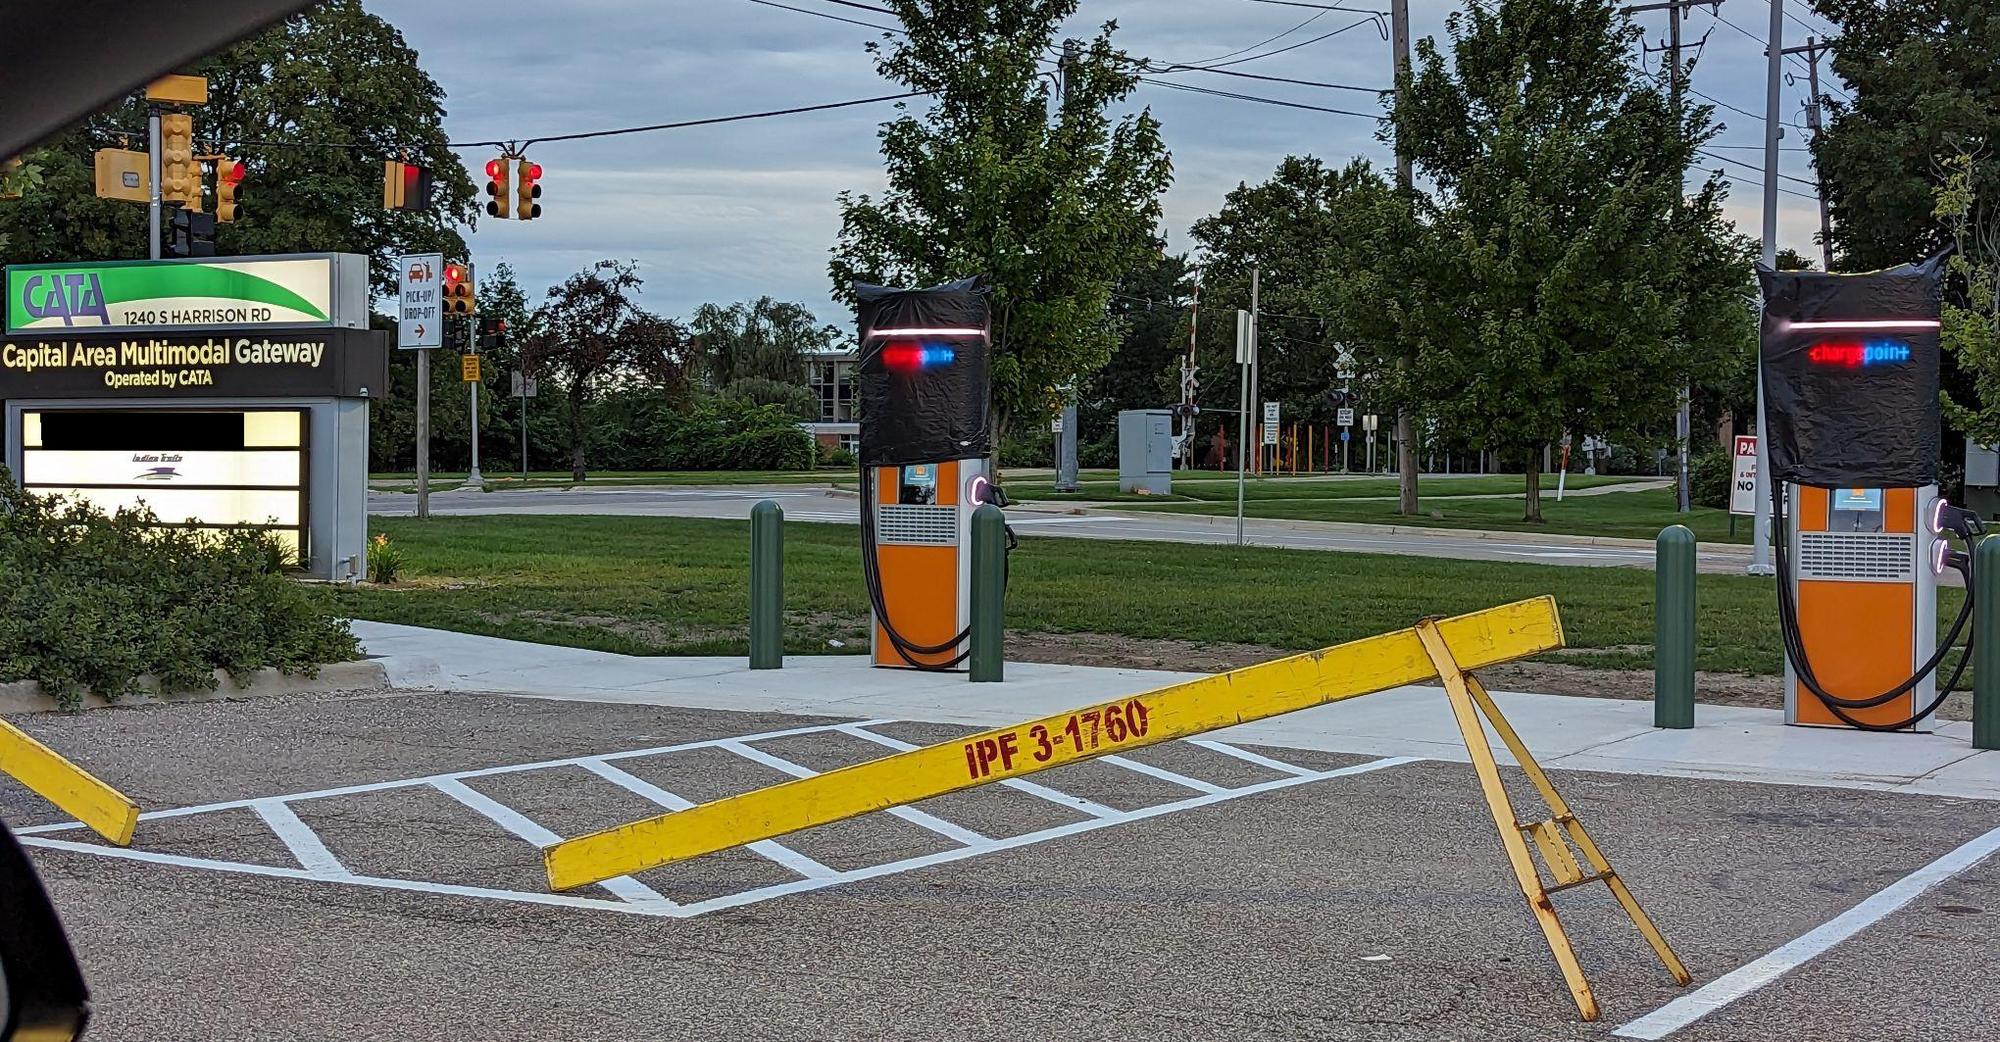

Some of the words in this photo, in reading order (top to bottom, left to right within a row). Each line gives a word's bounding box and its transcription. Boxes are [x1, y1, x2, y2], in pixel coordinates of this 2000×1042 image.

[23, 273, 112, 327] CATA
[124, 311, 156, 326] 1240
[160, 311, 168, 324] S
[171, 308, 247, 323] HARRISON
[251, 308, 272, 322] RD
[404, 306, 436, 320] DROP-OFF
[2, 341, 68, 372] Capital
[71, 342, 117, 367] Area
[121, 339, 231, 367] Multimodal
[234, 338, 325, 368] Gateway
[105, 370, 160, 389] Operated
[161, 369, 177, 389] by
[179, 369, 213, 386] CATA
[1740, 442, 1755, 455] PA
[1737, 480, 1754, 491] NO
[964, 732, 1019, 780] IPF
[1028, 698, 1150, 763] 3-1760
